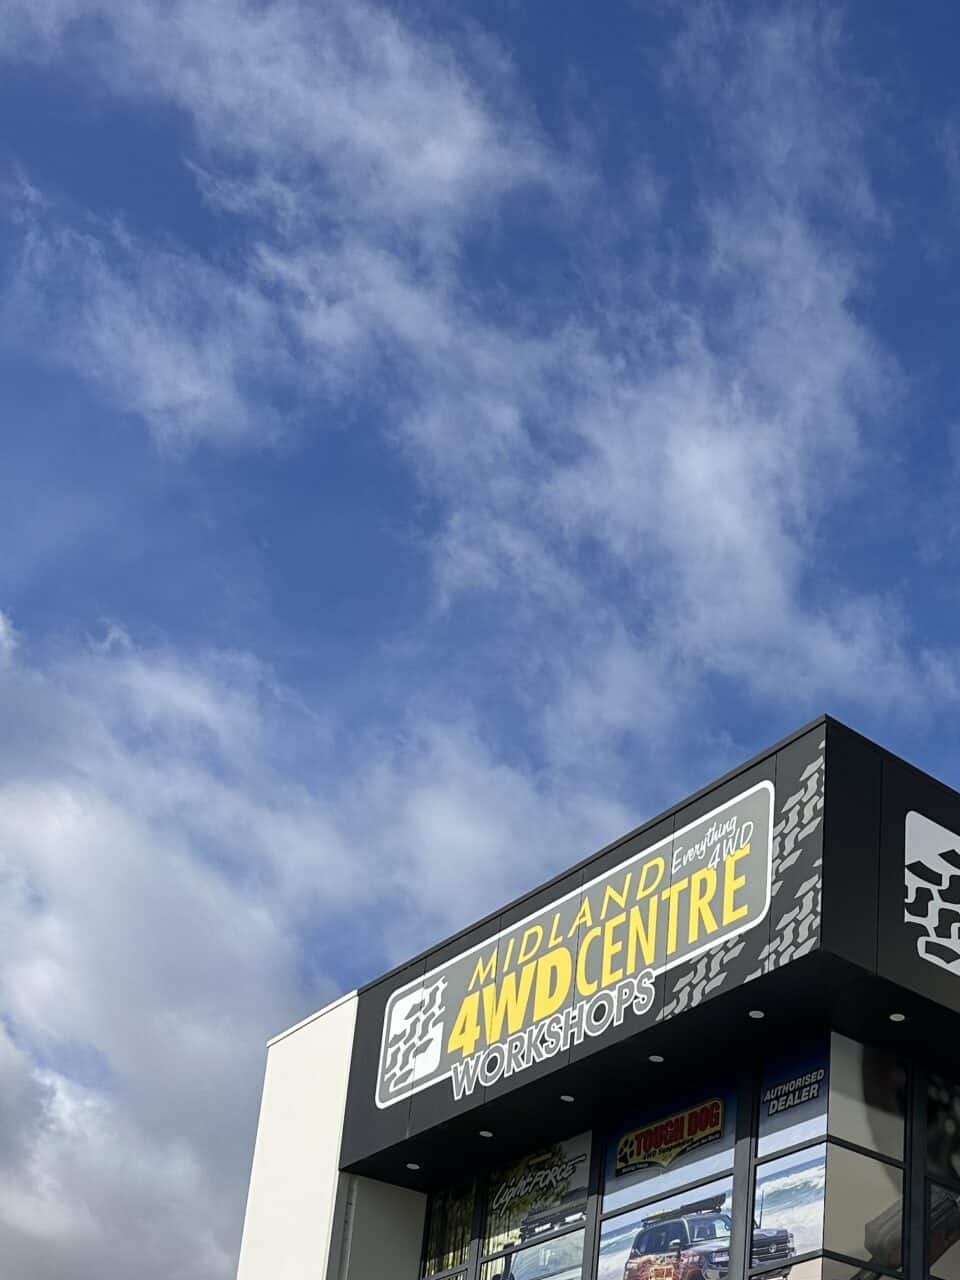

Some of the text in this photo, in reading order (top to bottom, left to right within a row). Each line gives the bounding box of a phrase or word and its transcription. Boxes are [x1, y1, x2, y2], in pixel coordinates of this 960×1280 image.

[671, 816, 738, 875] Everything
[708, 821, 754, 869] 4WD
[468, 856, 665, 991] MIDLAND
[450, 967, 656, 1101] WORKSHOPS
[763, 1068, 825, 1103] AUTHORISED
[768, 1083, 819, 1116] DEALER
[687, 1101, 721, 1137] DOG
